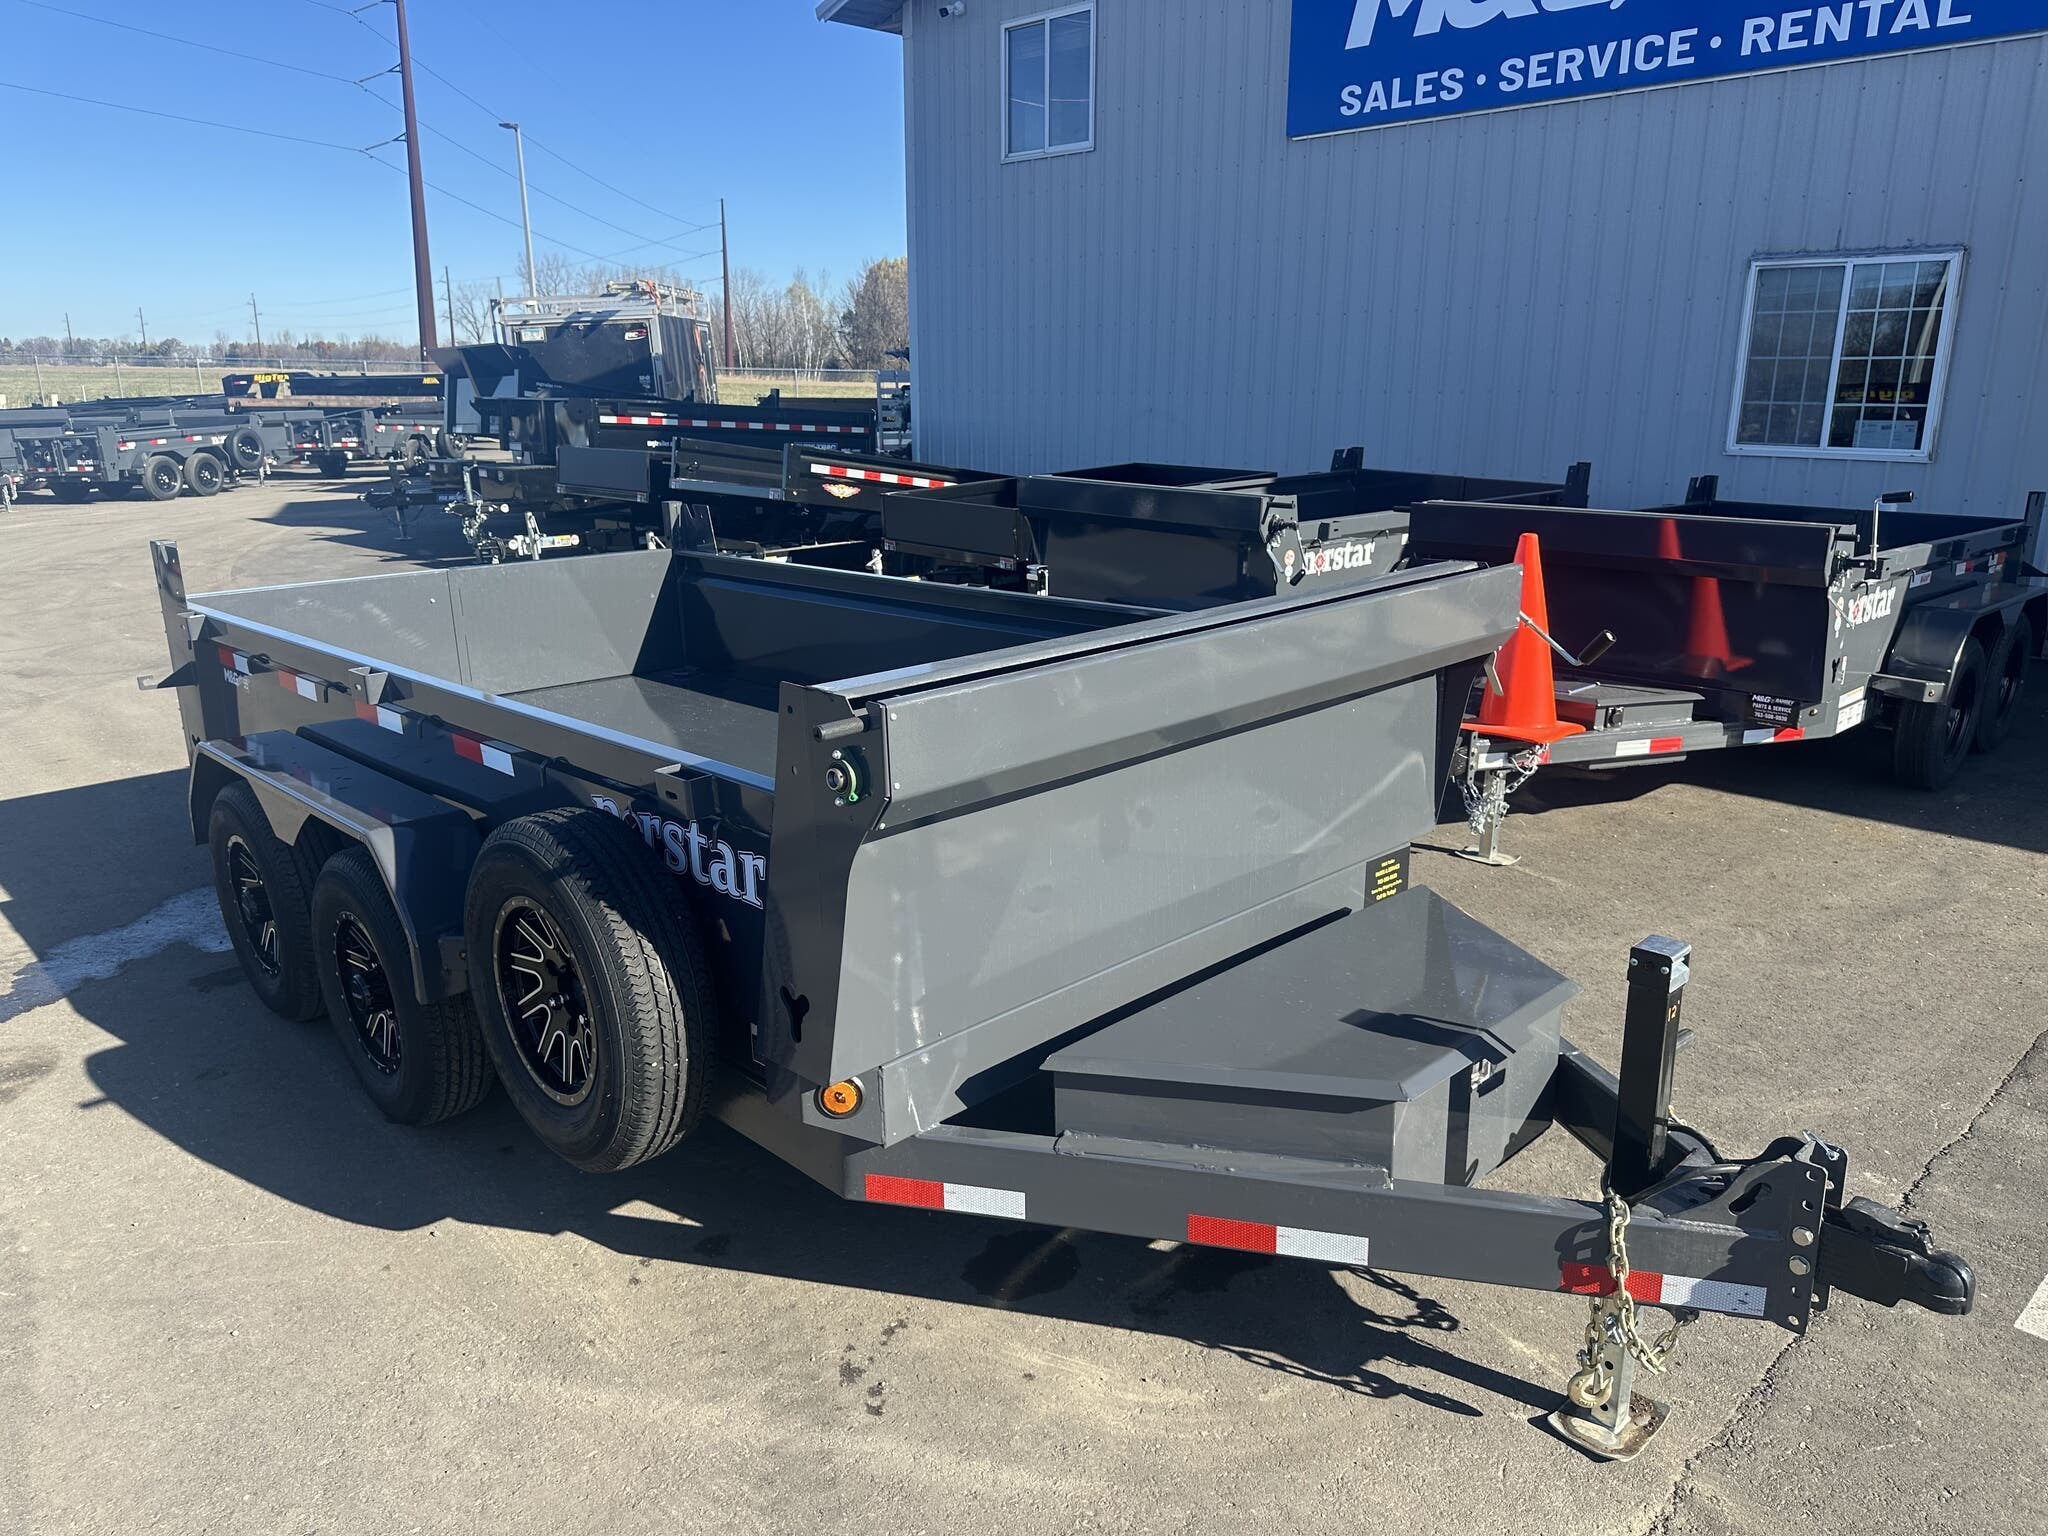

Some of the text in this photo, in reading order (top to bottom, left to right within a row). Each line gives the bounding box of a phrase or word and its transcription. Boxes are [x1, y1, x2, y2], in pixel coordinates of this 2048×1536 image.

[1339, 0, 1973, 117] SALES SERVICE RENTAL
[1302, 541, 1376, 577] norstar
